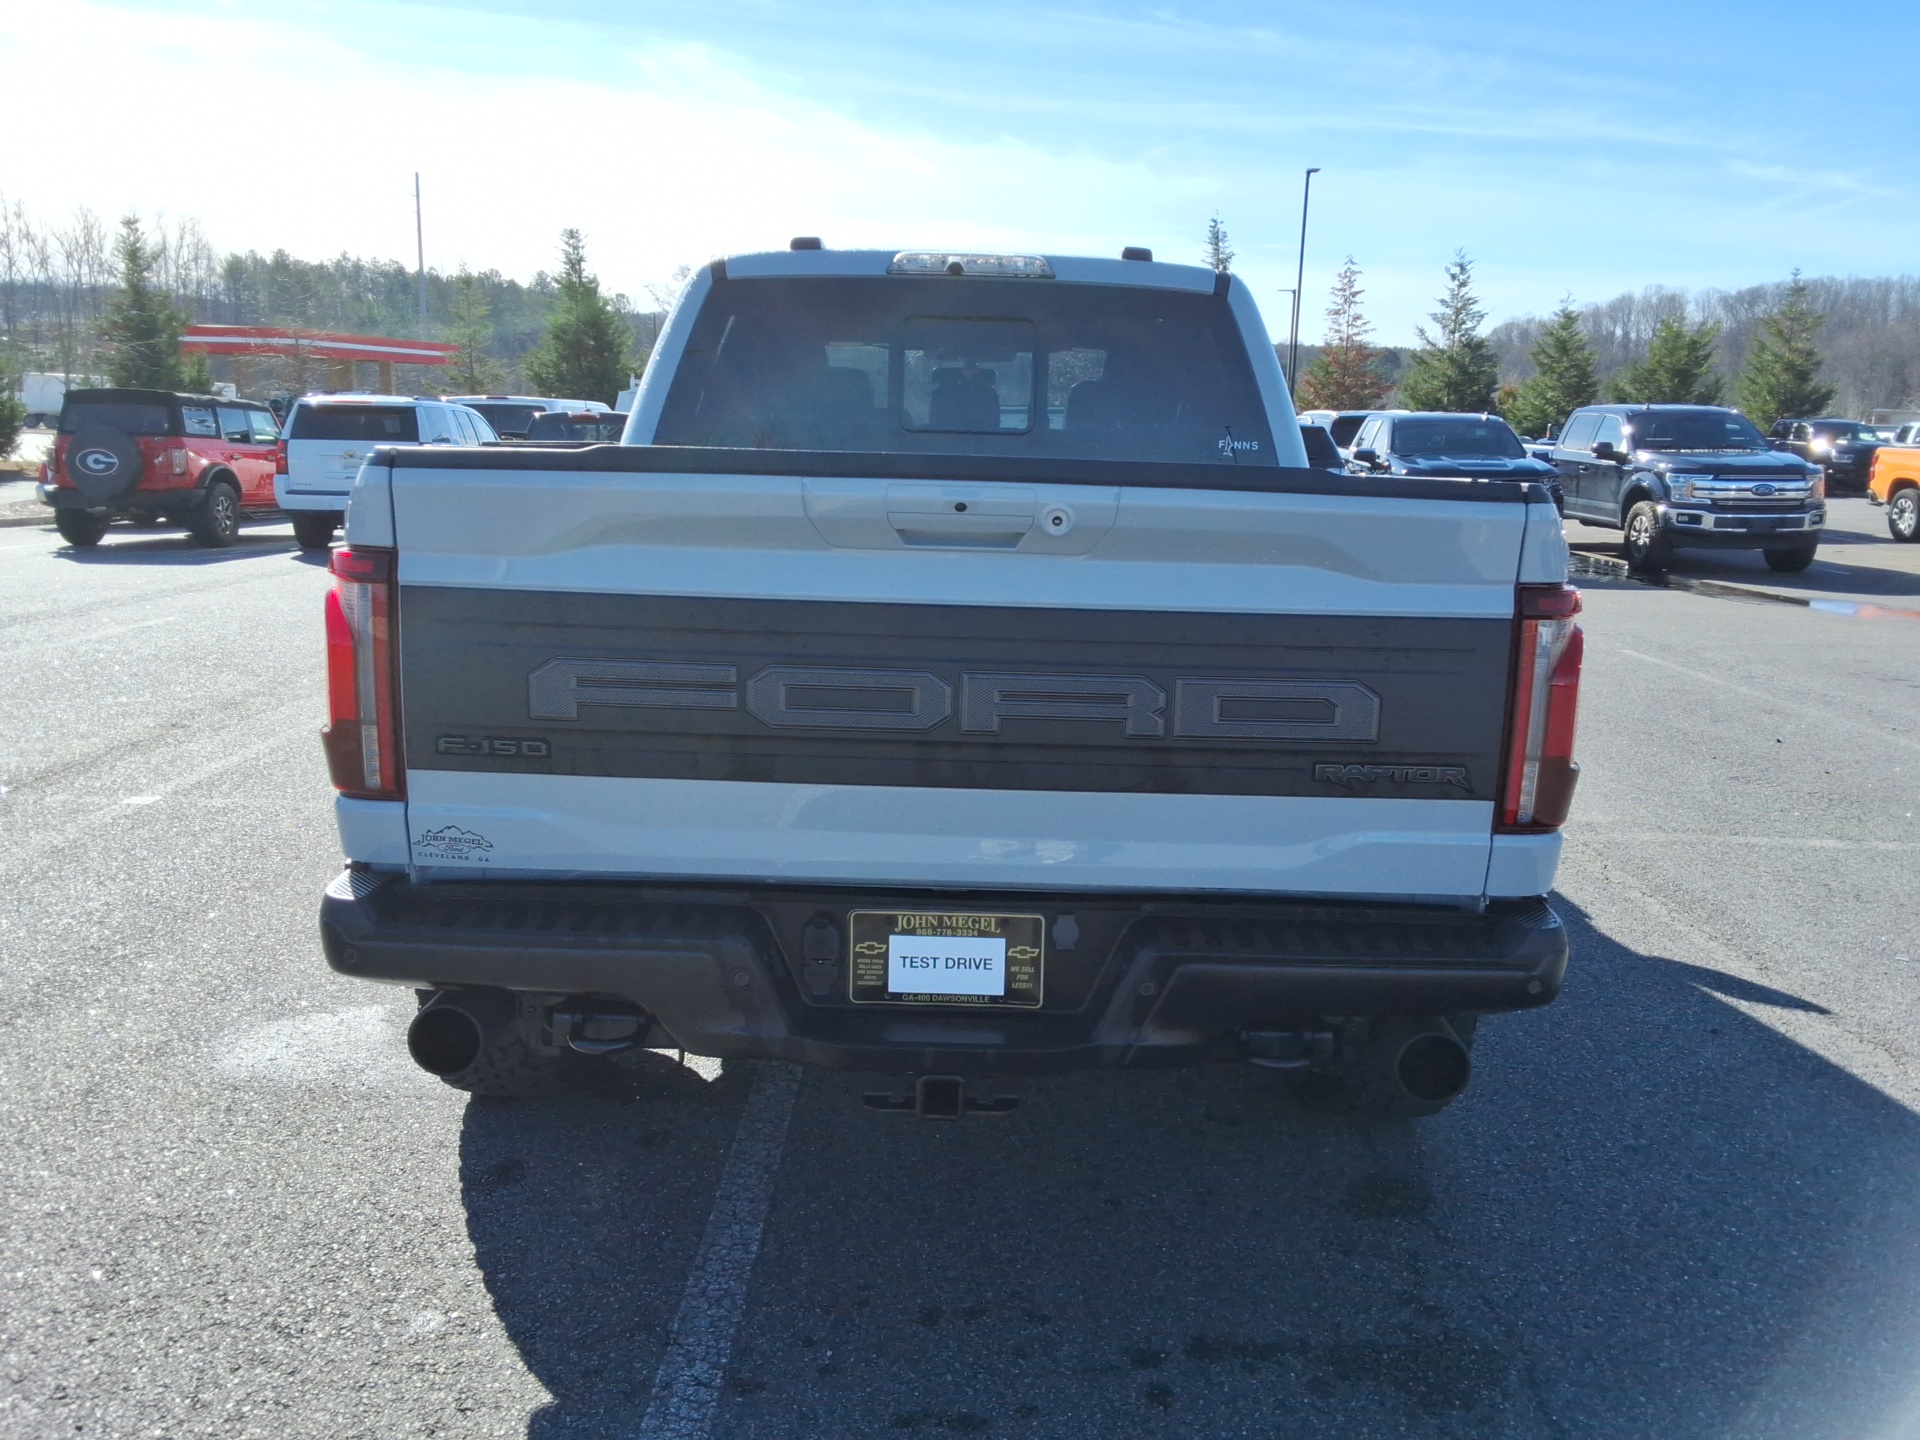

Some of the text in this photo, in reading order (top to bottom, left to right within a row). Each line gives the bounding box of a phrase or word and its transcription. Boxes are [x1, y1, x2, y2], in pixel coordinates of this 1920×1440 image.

[527, 656, 1382, 744] FORD
[437, 735, 551, 757] F-150
[1313, 763, 1470, 793] RAPTOR
[421, 834, 484, 846] JOHN MEGEL
[418, 851, 473, 862] CLEVELAND,
[895, 915, 1001, 933] JOHN MEGEL
[899, 955, 994, 971] TEST DRIVE
[902, 994, 990, 1004] GA-400 DAWSONVILLE
